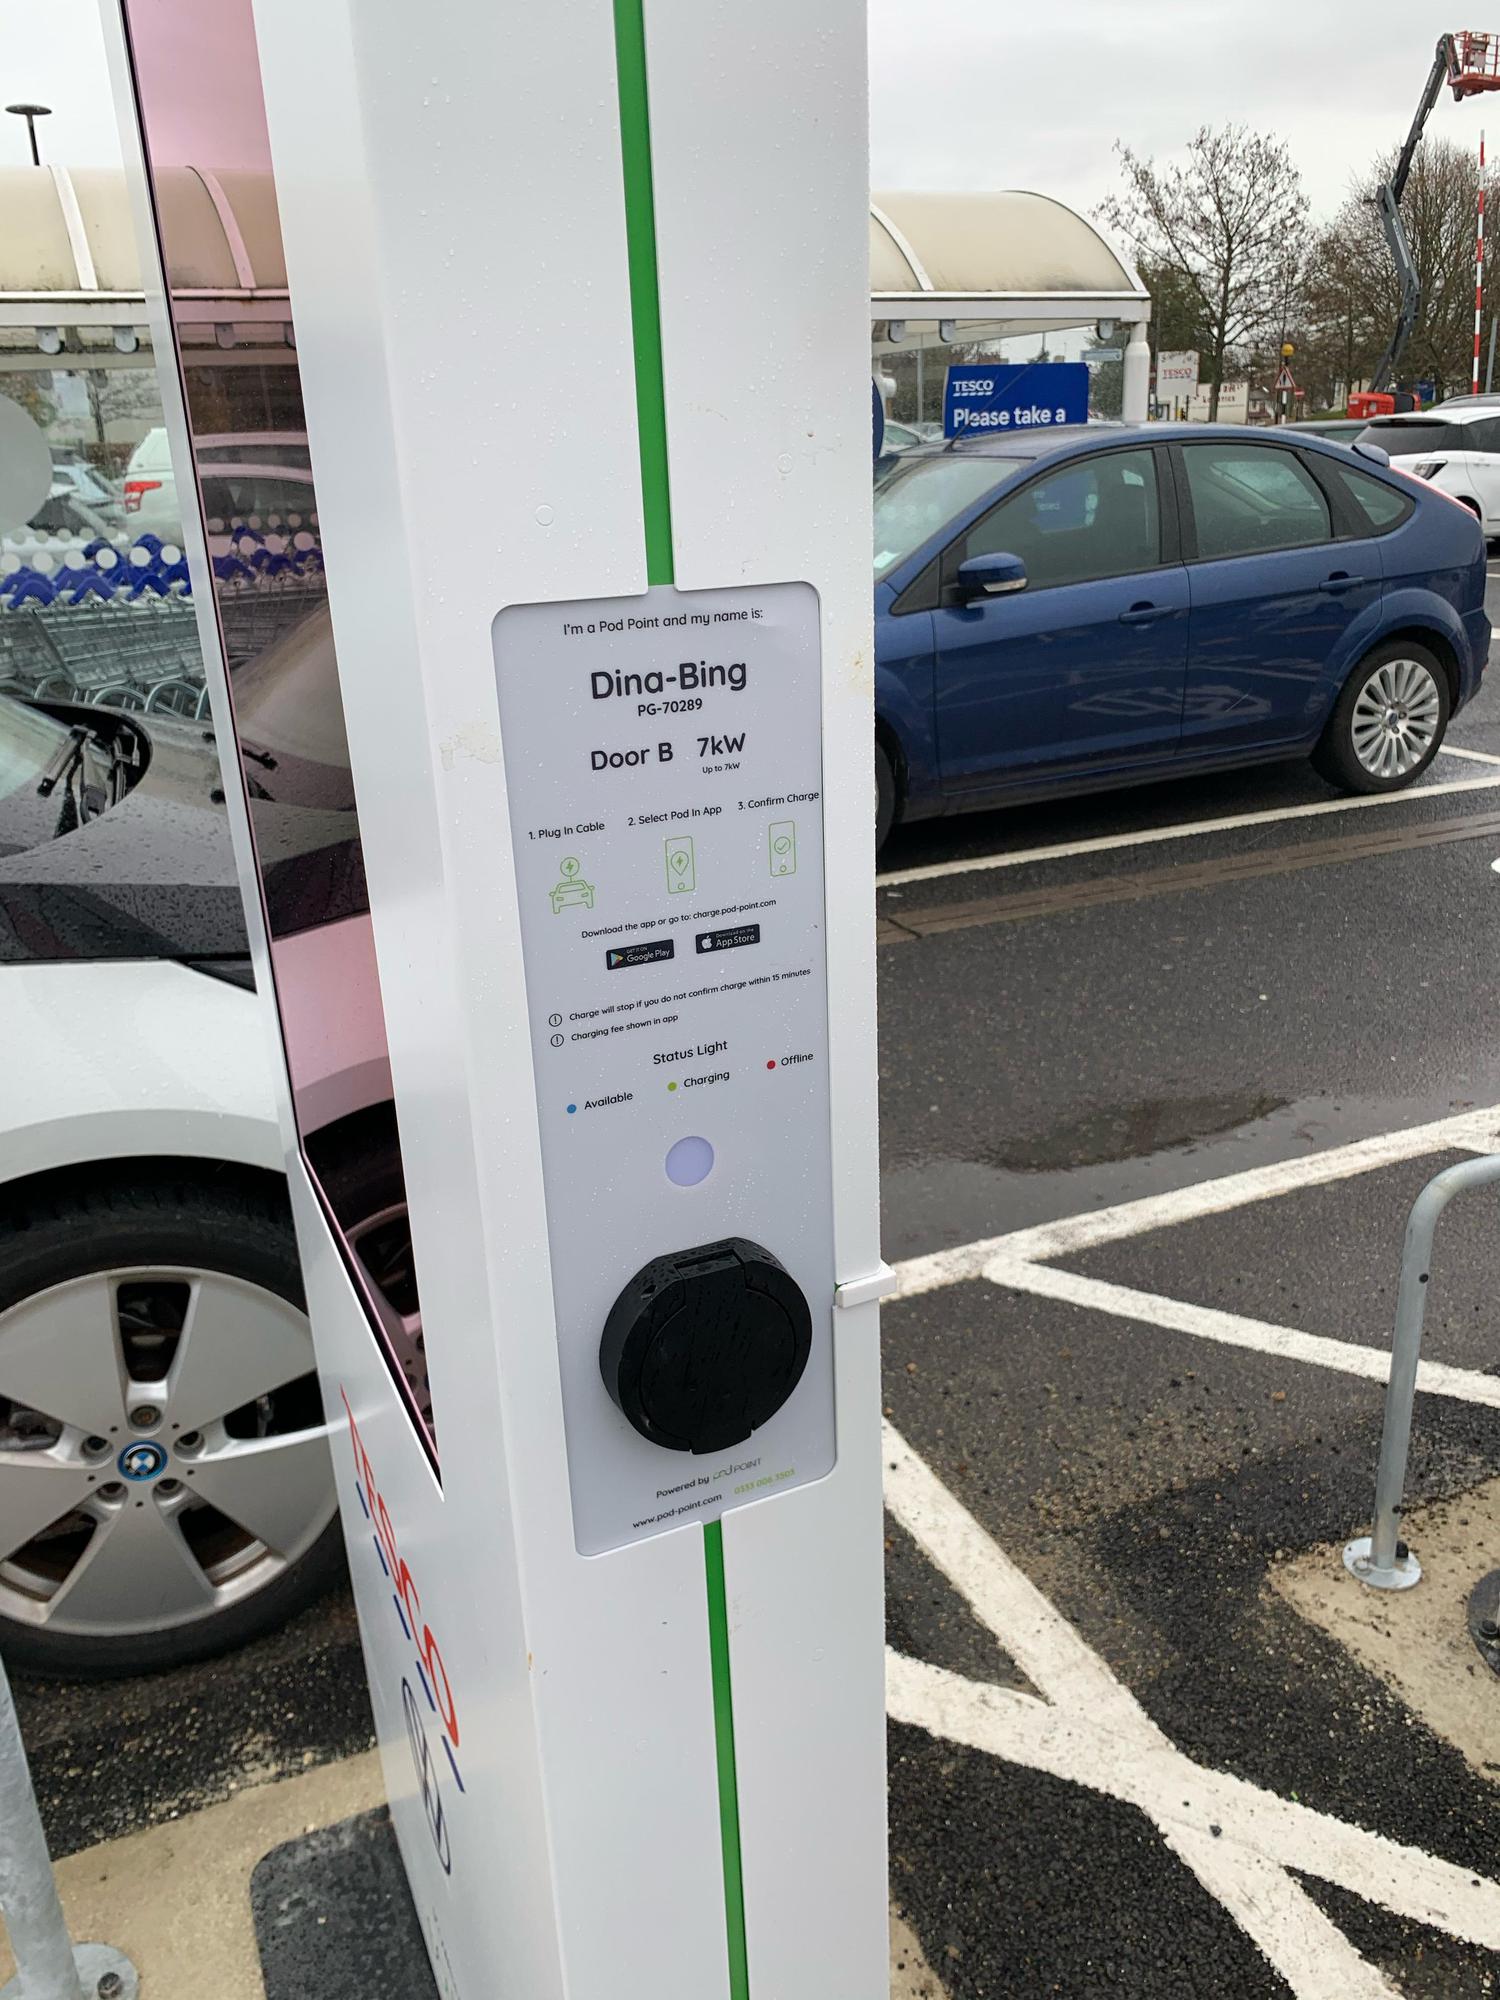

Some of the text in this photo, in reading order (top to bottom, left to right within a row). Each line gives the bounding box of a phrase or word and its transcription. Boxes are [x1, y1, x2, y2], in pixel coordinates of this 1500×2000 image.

[953, 380, 994, 392] TESCO
[953, 405, 1066, 428] Please take a
[563, 608, 763, 635] I'm a Pod Point and my name is:
[591, 660, 747, 700] Dina-Bing
[637, 698, 703, 717] PG-70289
[591, 733, 746, 771] Door B 7kW
[702, 762, 740, 775] Up to 7kW
[738, 791, 820, 811] 3. Confirm Charge
[628, 805, 722, 826] 2. Select Pod In App
[528, 822, 605, 841] 1. Plug In Cable
[581, 899, 777, 939] Download the app or go to: charge.pod-point.com
[716, 930, 739, 938] Download
[716, 934, 755, 949] App Store
[627, 948, 670, 963] Google Play
[569, 967, 811, 1021] Charge will stop if you do not confirm charge within 15 minutes
[571, 1014, 679, 1042] Charging fee shown in app
[653, 1040, 728, 1065] Status Light
[781, 1052, 814, 1067] Offline
[683, 1070, 730, 1088] Charging
[584, 1091, 633, 1111] Available
[656, 1478, 696, 1498] Powered
[698, 1475, 710, 1485] by
[632, 1493, 722, 1529] www.pod-point.com
[340, 1384, 459, 1748] TESCO
